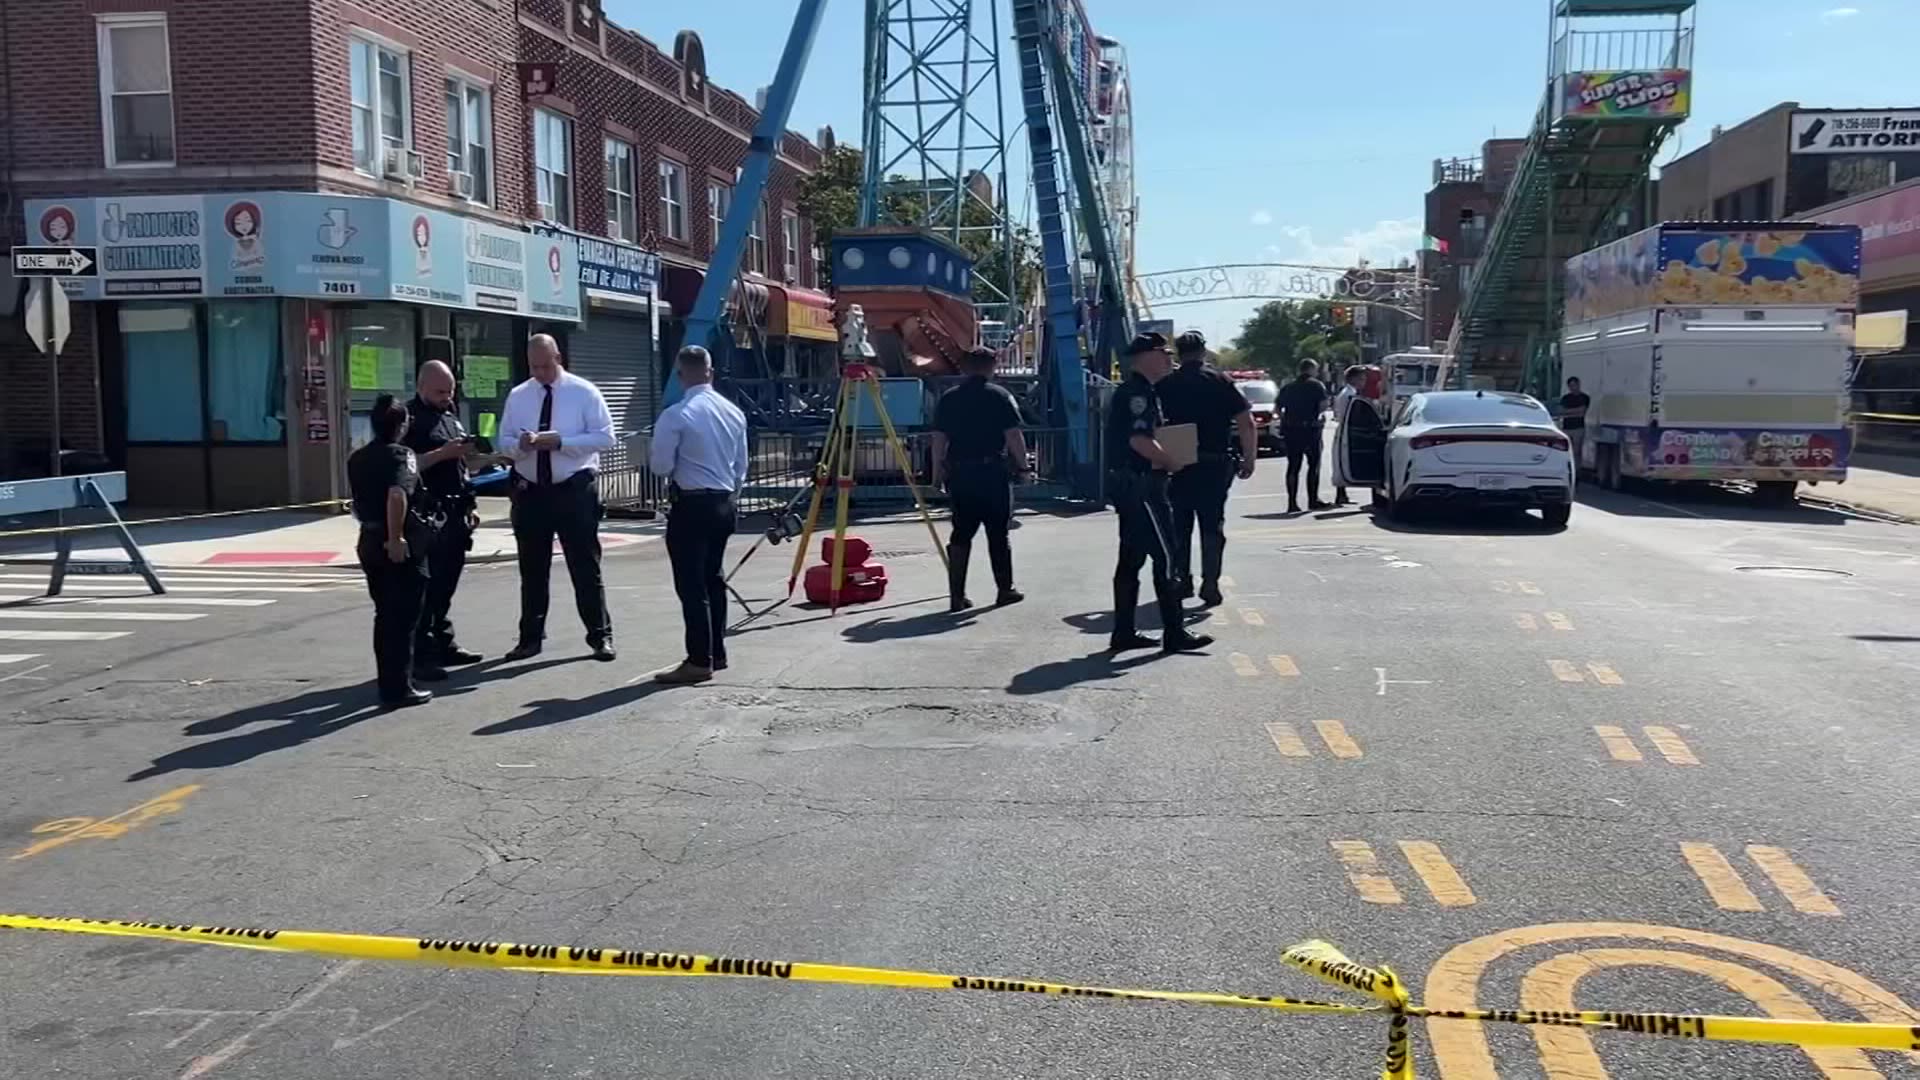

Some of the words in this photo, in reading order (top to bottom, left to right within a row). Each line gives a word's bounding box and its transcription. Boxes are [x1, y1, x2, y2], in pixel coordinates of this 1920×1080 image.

[1581, 75, 1642, 104] SUPER
[1616, 81, 1677, 109] SLIDE
[21, 256, 43, 267] ONE
[56, 256, 82, 267] WAY
[324, 282, 356, 293] 7401
